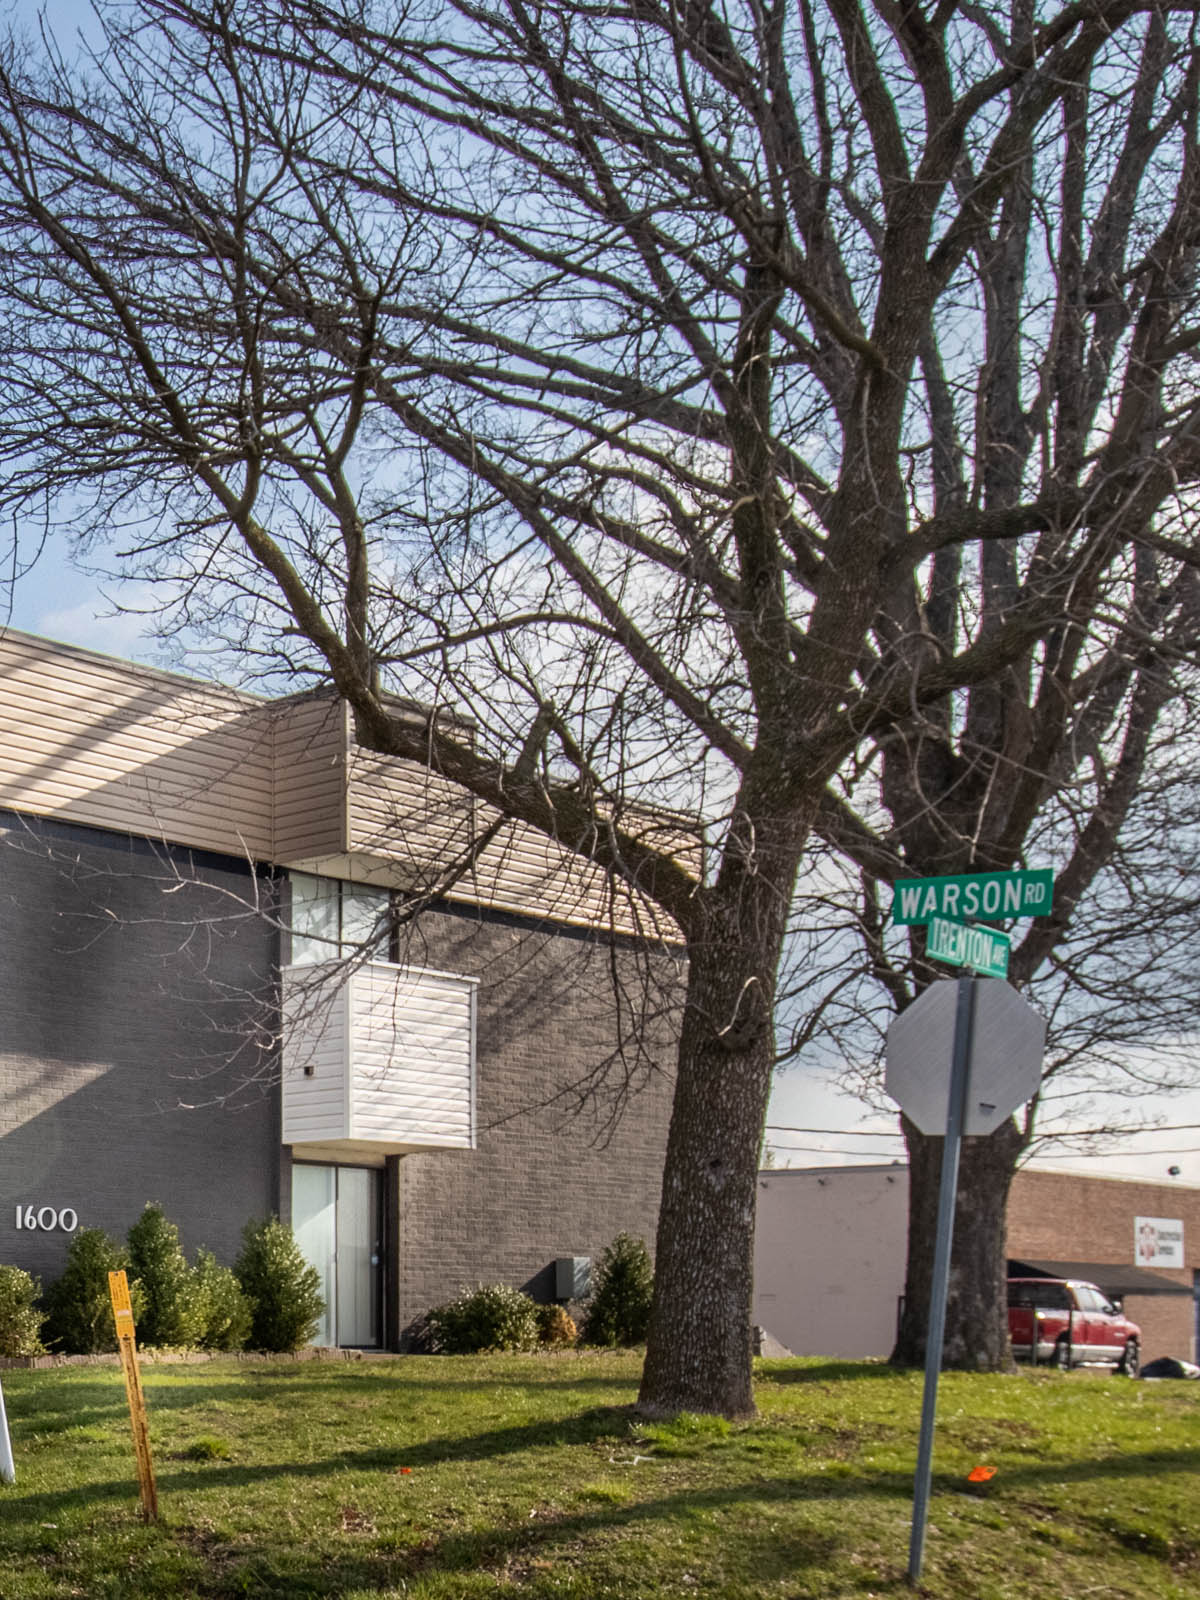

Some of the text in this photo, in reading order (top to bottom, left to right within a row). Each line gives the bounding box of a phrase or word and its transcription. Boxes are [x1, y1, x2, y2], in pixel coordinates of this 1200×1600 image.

[901, 878, 1046, 919] WARSON RD
[932, 917, 994, 968] TRENTON
[15, 1205, 78, 1232] 1600
